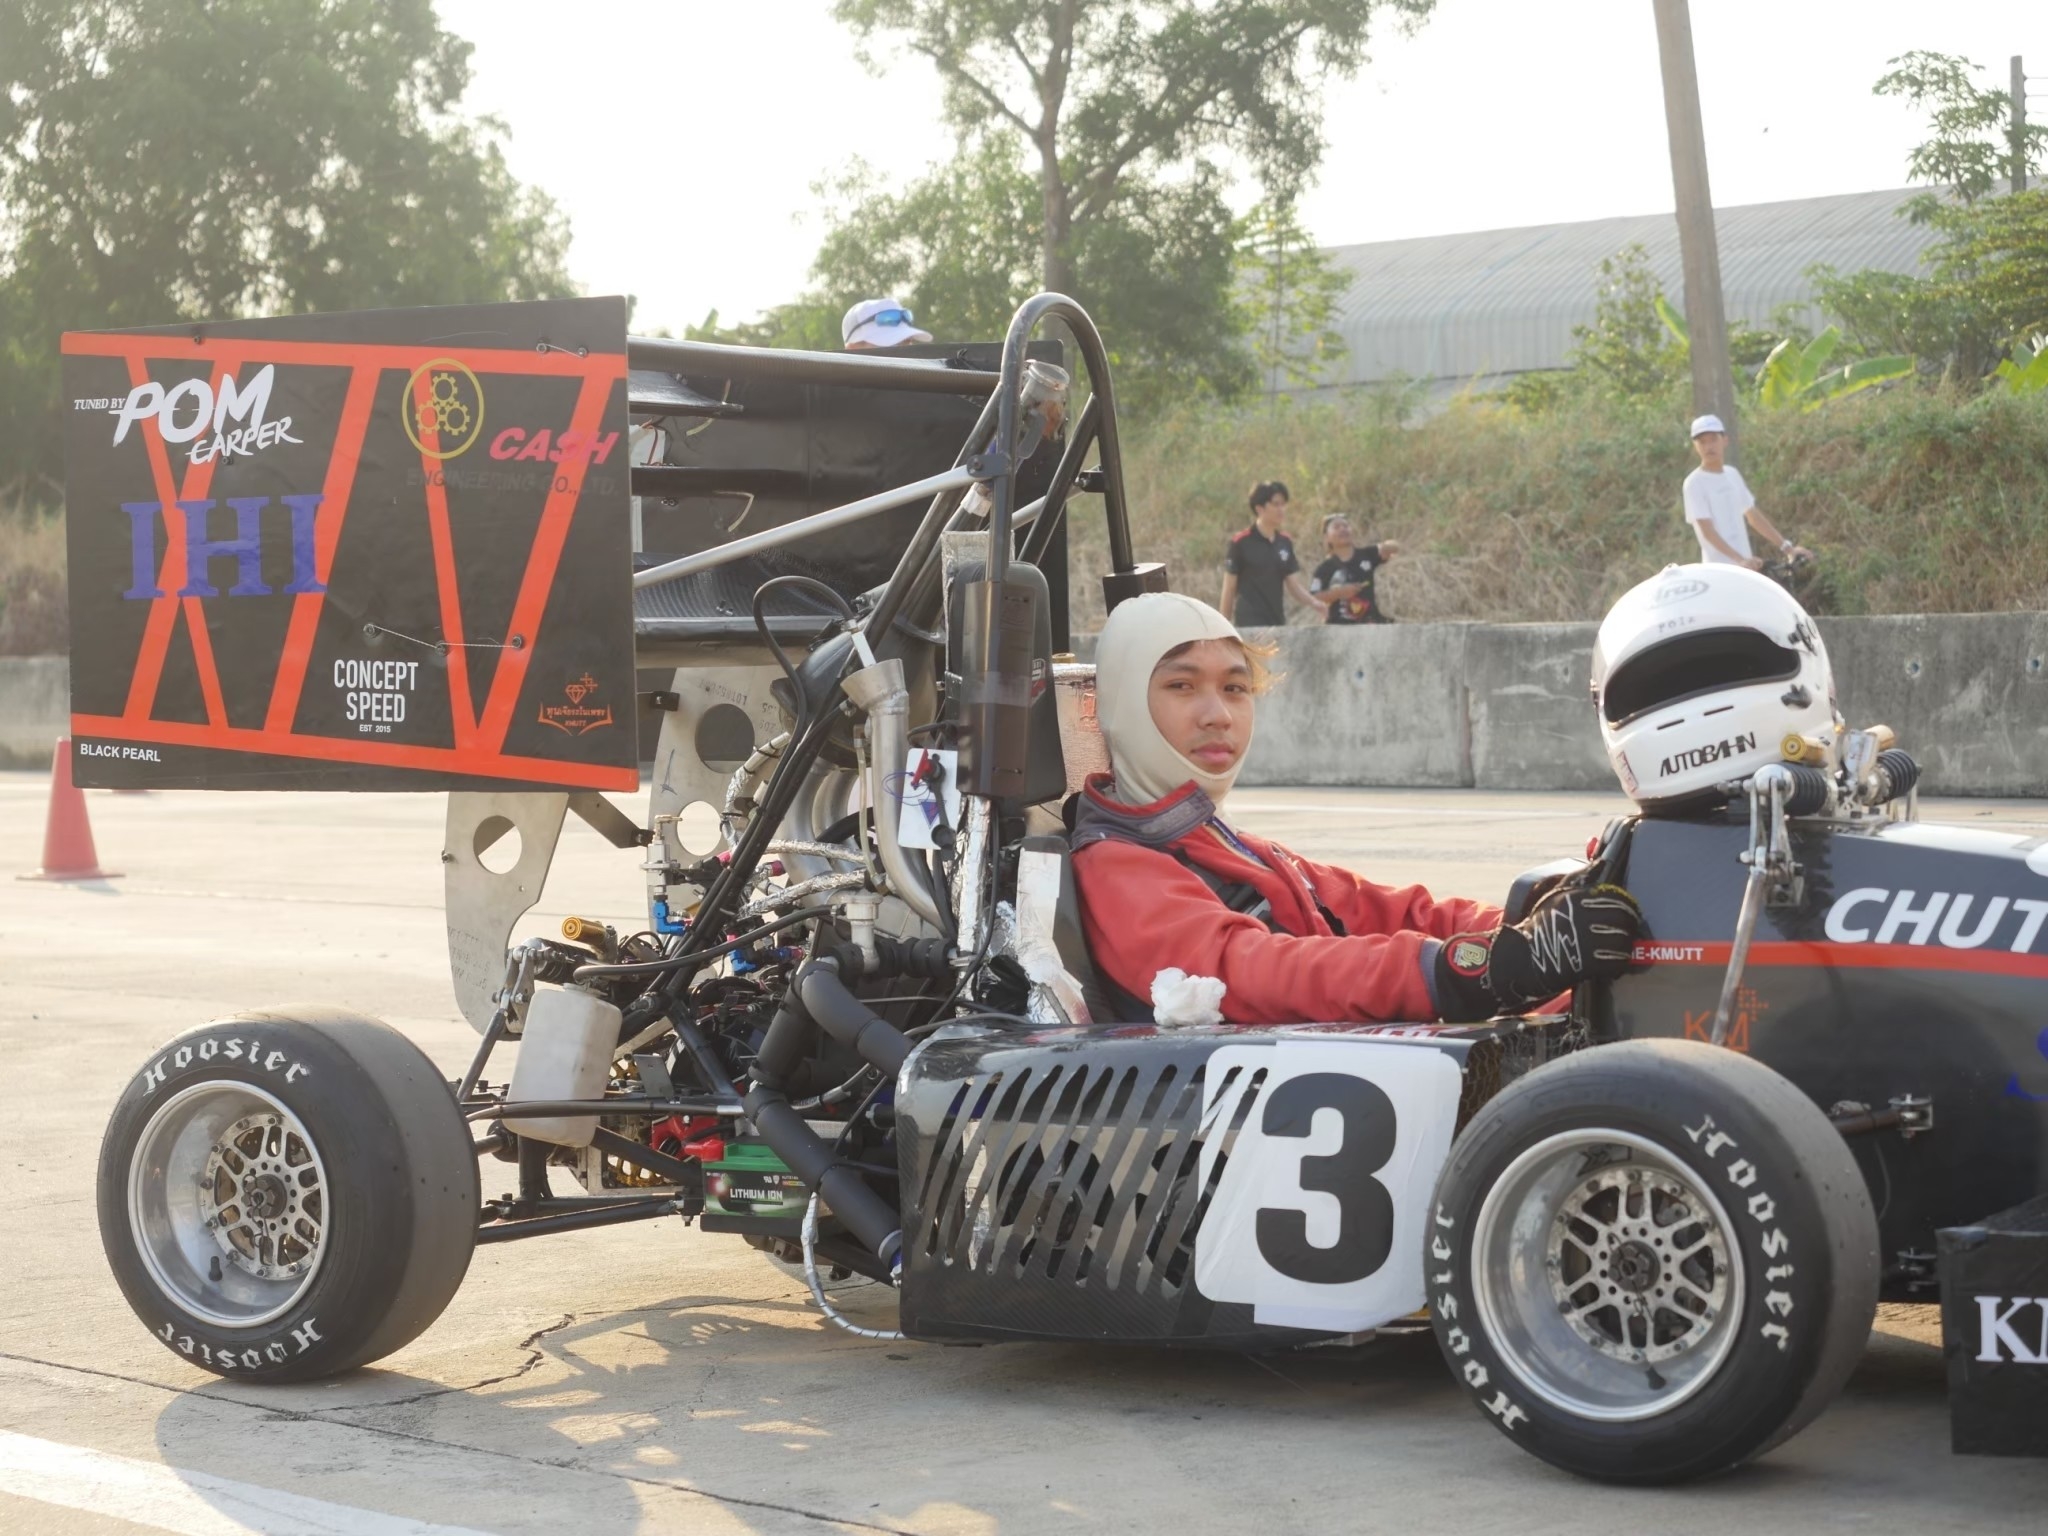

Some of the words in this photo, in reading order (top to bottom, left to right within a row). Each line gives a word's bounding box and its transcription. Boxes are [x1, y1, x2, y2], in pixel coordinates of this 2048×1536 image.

[74, 398, 109, 410] TUNED
[110, 397, 126, 409] BY
[109, 364, 275, 447] POM
[489, 427, 620, 464] CASH
[121, 494, 327, 600] IHI
[334, 659, 419, 691] CONCEPT
[346, 691, 406, 722] SPEED
[359, 724, 373, 732] EST
[375, 725, 391, 733] 2015
[80, 743, 120, 758] BLACK
[122, 747, 162, 762] PEARL
[1660, 731, 1756, 777] AUTOBAHN
[1632, 946, 1704, 961] E-KMUTT
[143, 1037, 311, 1097] Hoosier
[729, 1188, 766, 1200] LITHIUM
[767, 1190, 784, 1201] ION
[1255, 1072, 1397, 1285] 3
[1682, 1113, 1795, 1351] Hoosier
[1431, 1202, 1530, 1431] Hoosier
[157, 1317, 323, 1370] Hoosier
